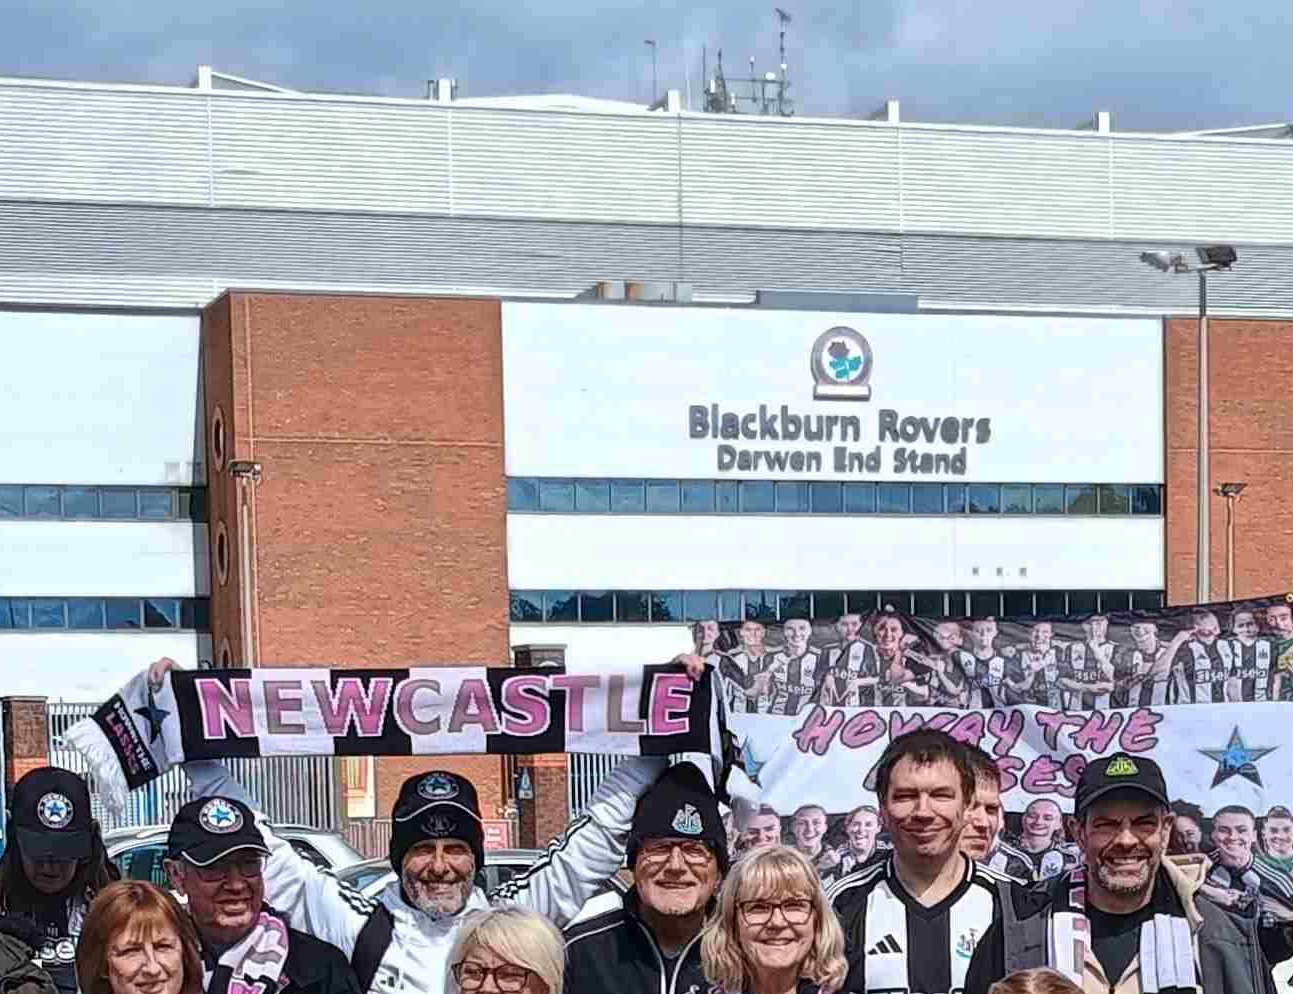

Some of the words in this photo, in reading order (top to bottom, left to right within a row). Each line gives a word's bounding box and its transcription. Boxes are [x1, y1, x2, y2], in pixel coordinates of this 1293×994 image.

[688, 403, 861, 443] Blackburn
[878, 408, 991, 444] Rovers
[716, 444, 822, 473] Darwen
[834, 445, 882, 473] End
[892, 446, 968, 475] Stand
[193, 672, 694, 738] NEWCASTLE
[1035, 707, 1164, 755] THE
[40, 940, 76, 960] se
